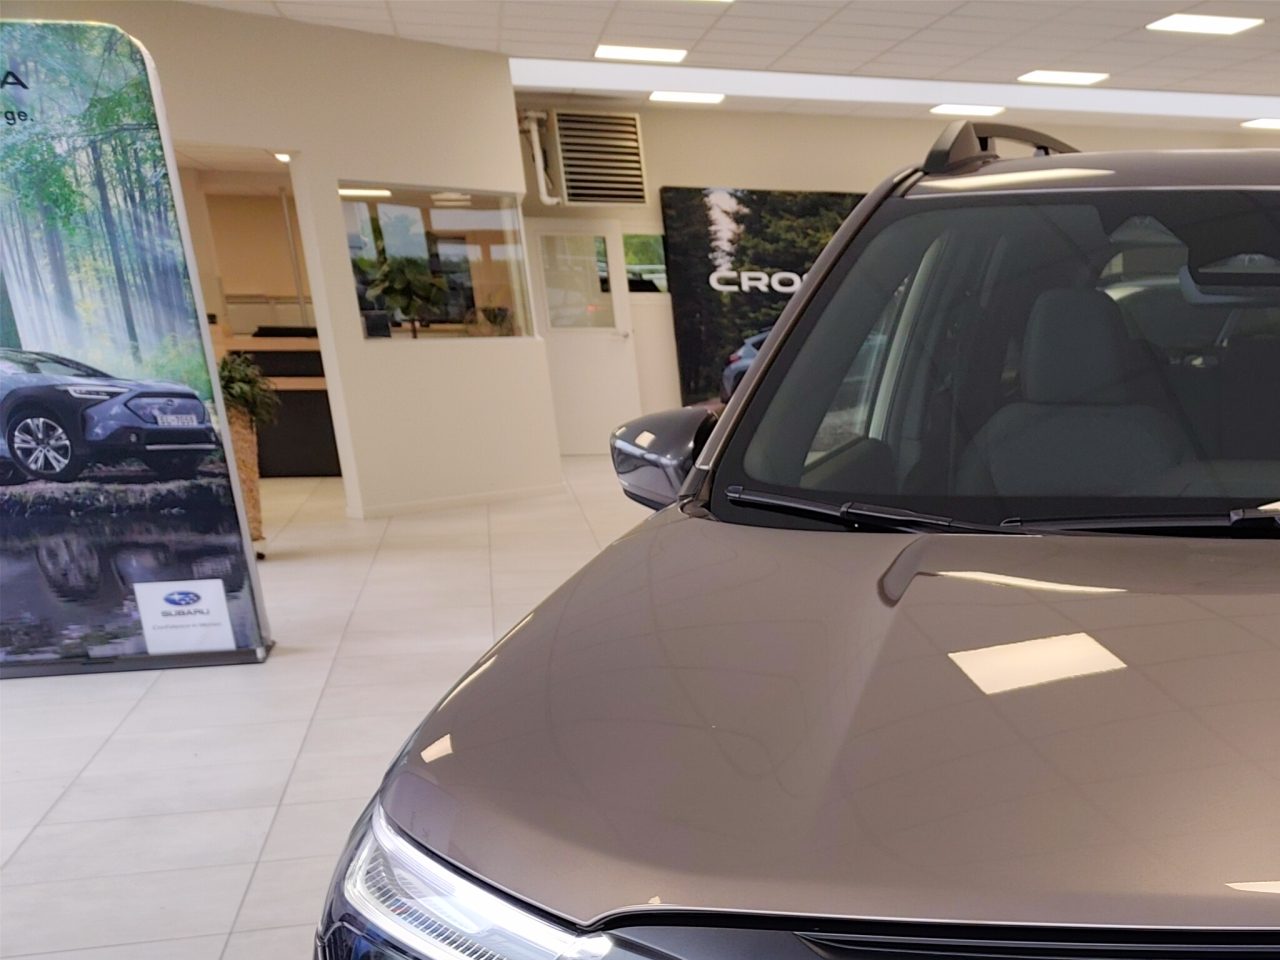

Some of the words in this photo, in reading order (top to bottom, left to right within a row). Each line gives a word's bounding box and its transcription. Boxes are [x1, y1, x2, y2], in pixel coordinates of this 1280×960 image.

[0, 110, 34, 126] ge.
[708, 270, 809, 293] CRO
[160, 608, 210, 617] SUBARU
